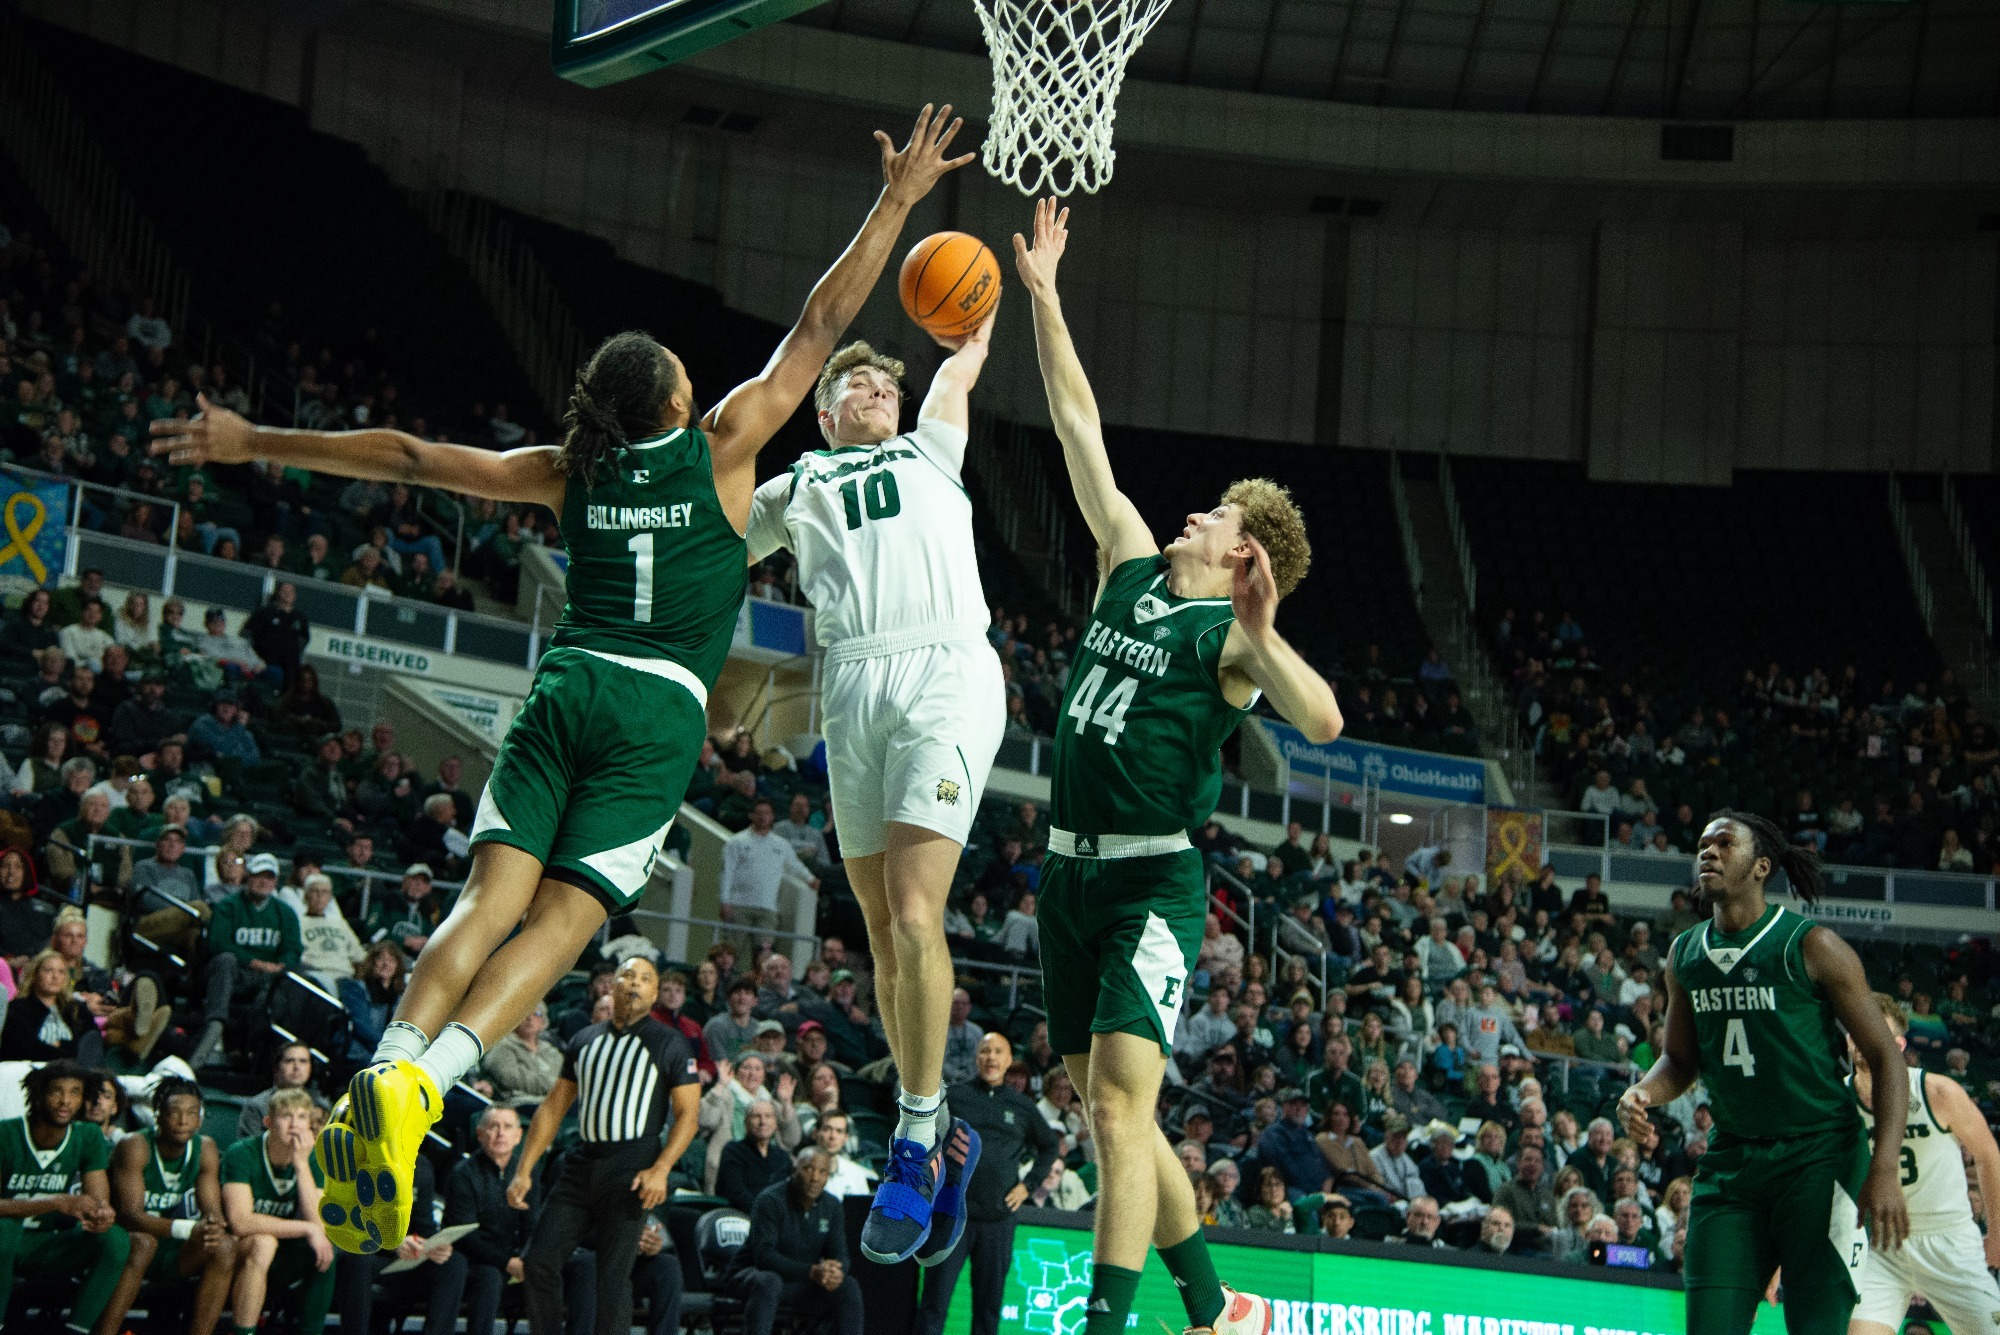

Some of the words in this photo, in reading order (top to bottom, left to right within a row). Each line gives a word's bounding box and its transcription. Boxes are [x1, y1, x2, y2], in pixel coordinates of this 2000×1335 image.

[632, 469, 650, 484] E
[587, 502, 693, 530] BILLINGSLEY
[838, 468, 901, 531] 10
[628, 532, 654, 623] 1
[327, 637, 429, 672] RESERVED
[1083, 619, 1172, 678] EASTERN
[1067, 663, 1140, 746] 44
[1390, 763, 1483, 791] OhioHealth
[1801, 903, 1893, 921] RESERVED
[1159, 975, 1182, 1009] E
[1691, 986, 1776, 1013] EASTERN
[1722, 1018, 1756, 1077] 4
[7, 1173, 69, 1191] EASTERN
[1850, 1242, 1864, 1268] E
[1263, 1297, 1434, 1335] RKERSBURG
